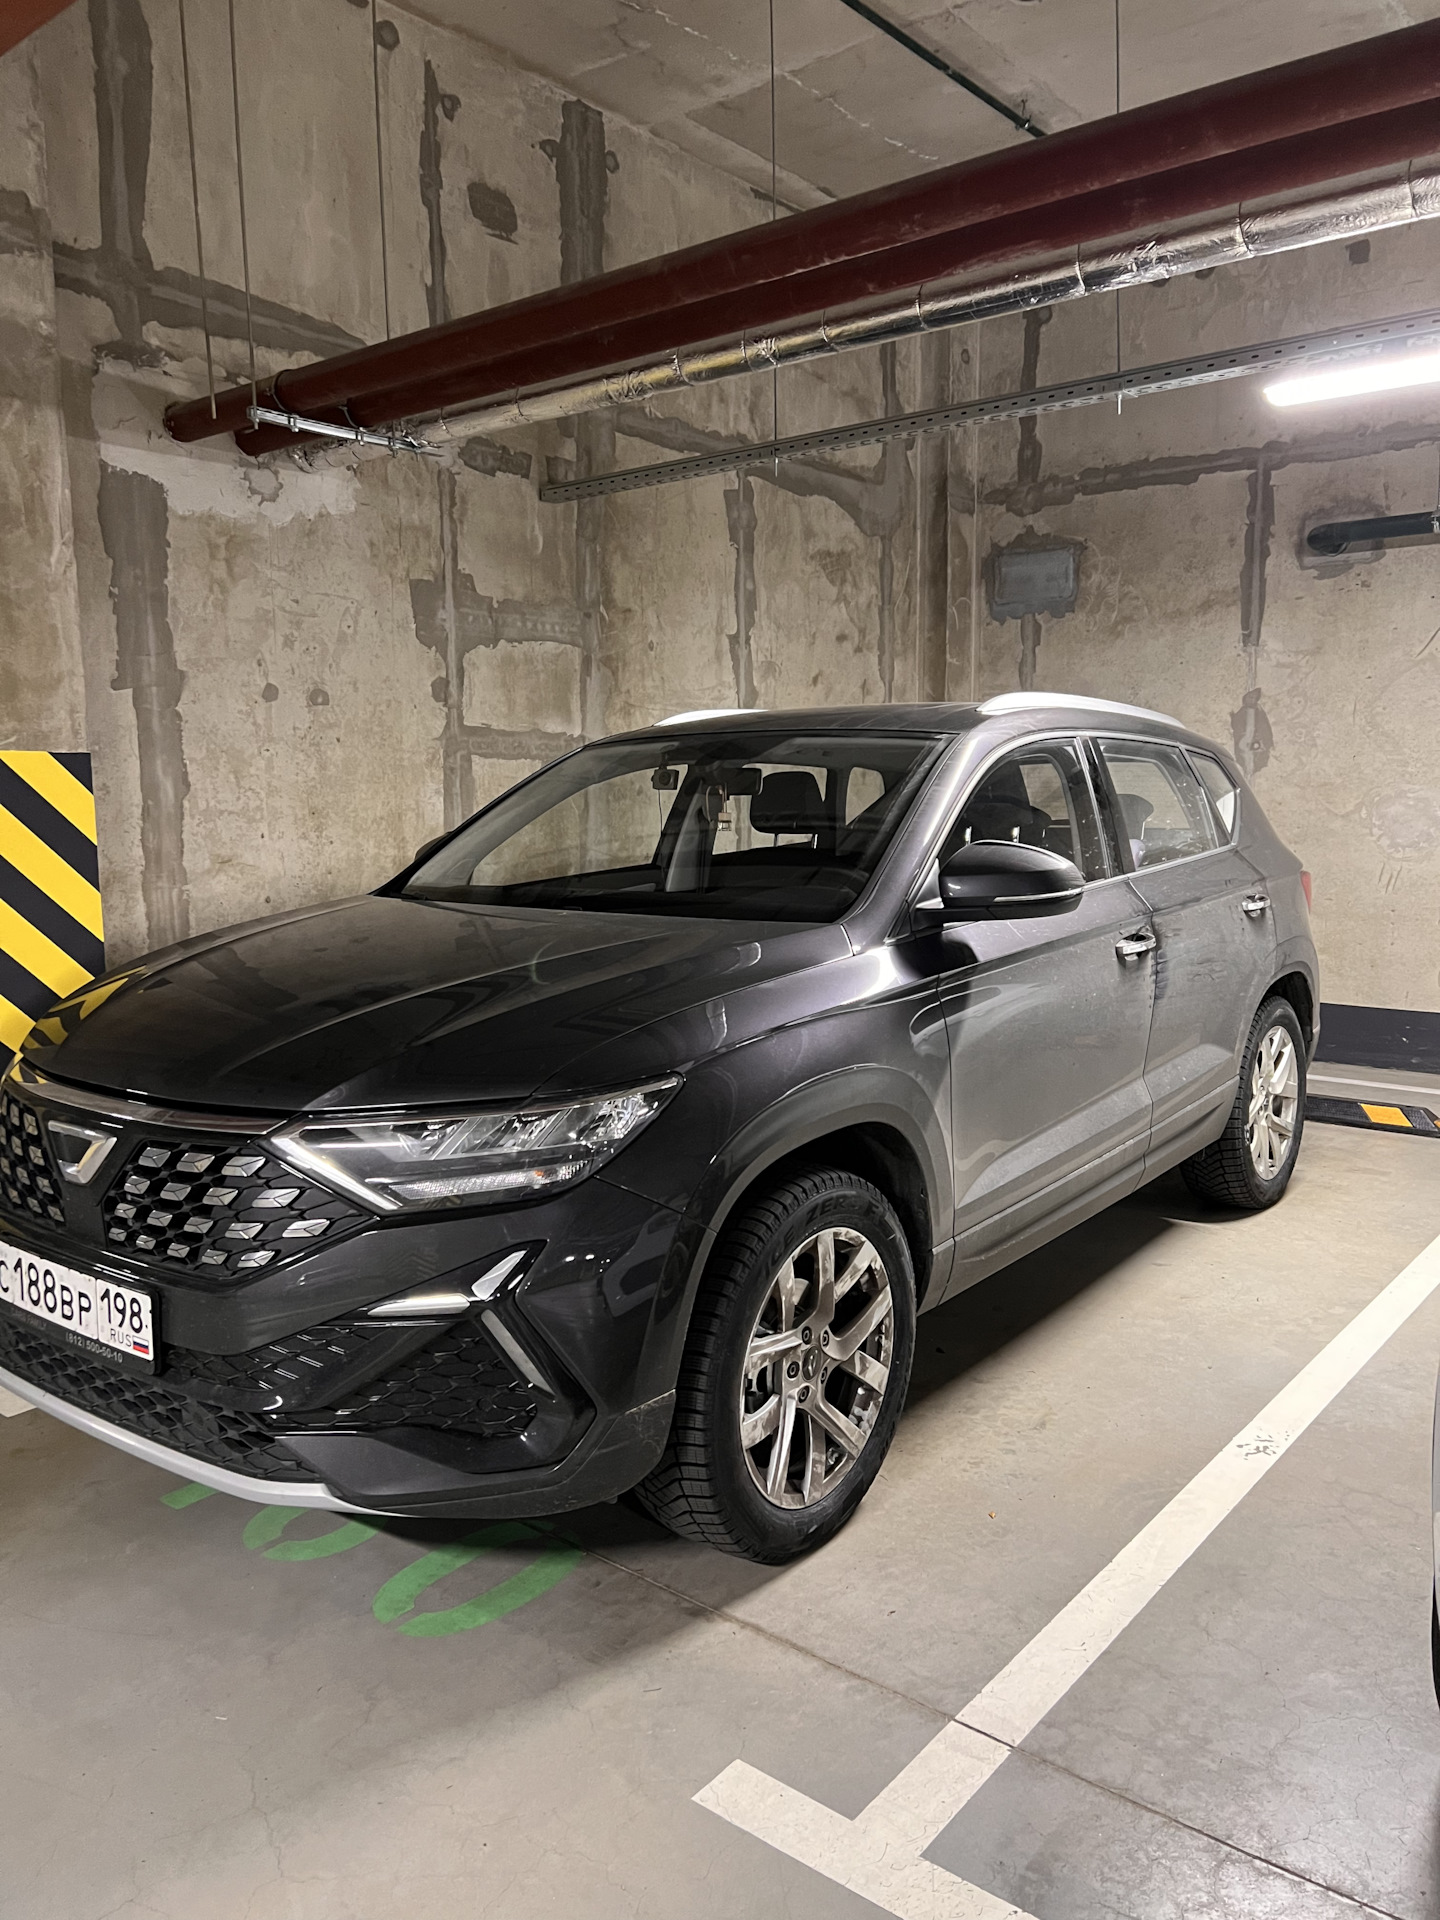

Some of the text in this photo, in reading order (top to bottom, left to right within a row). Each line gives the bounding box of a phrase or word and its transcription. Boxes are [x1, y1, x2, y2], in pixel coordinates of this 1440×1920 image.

[100, 1288, 143, 1334] 198
[65, 1332, 123, 1364] (812) 500-50-10
[110, 1328, 132, 1347] RUS
